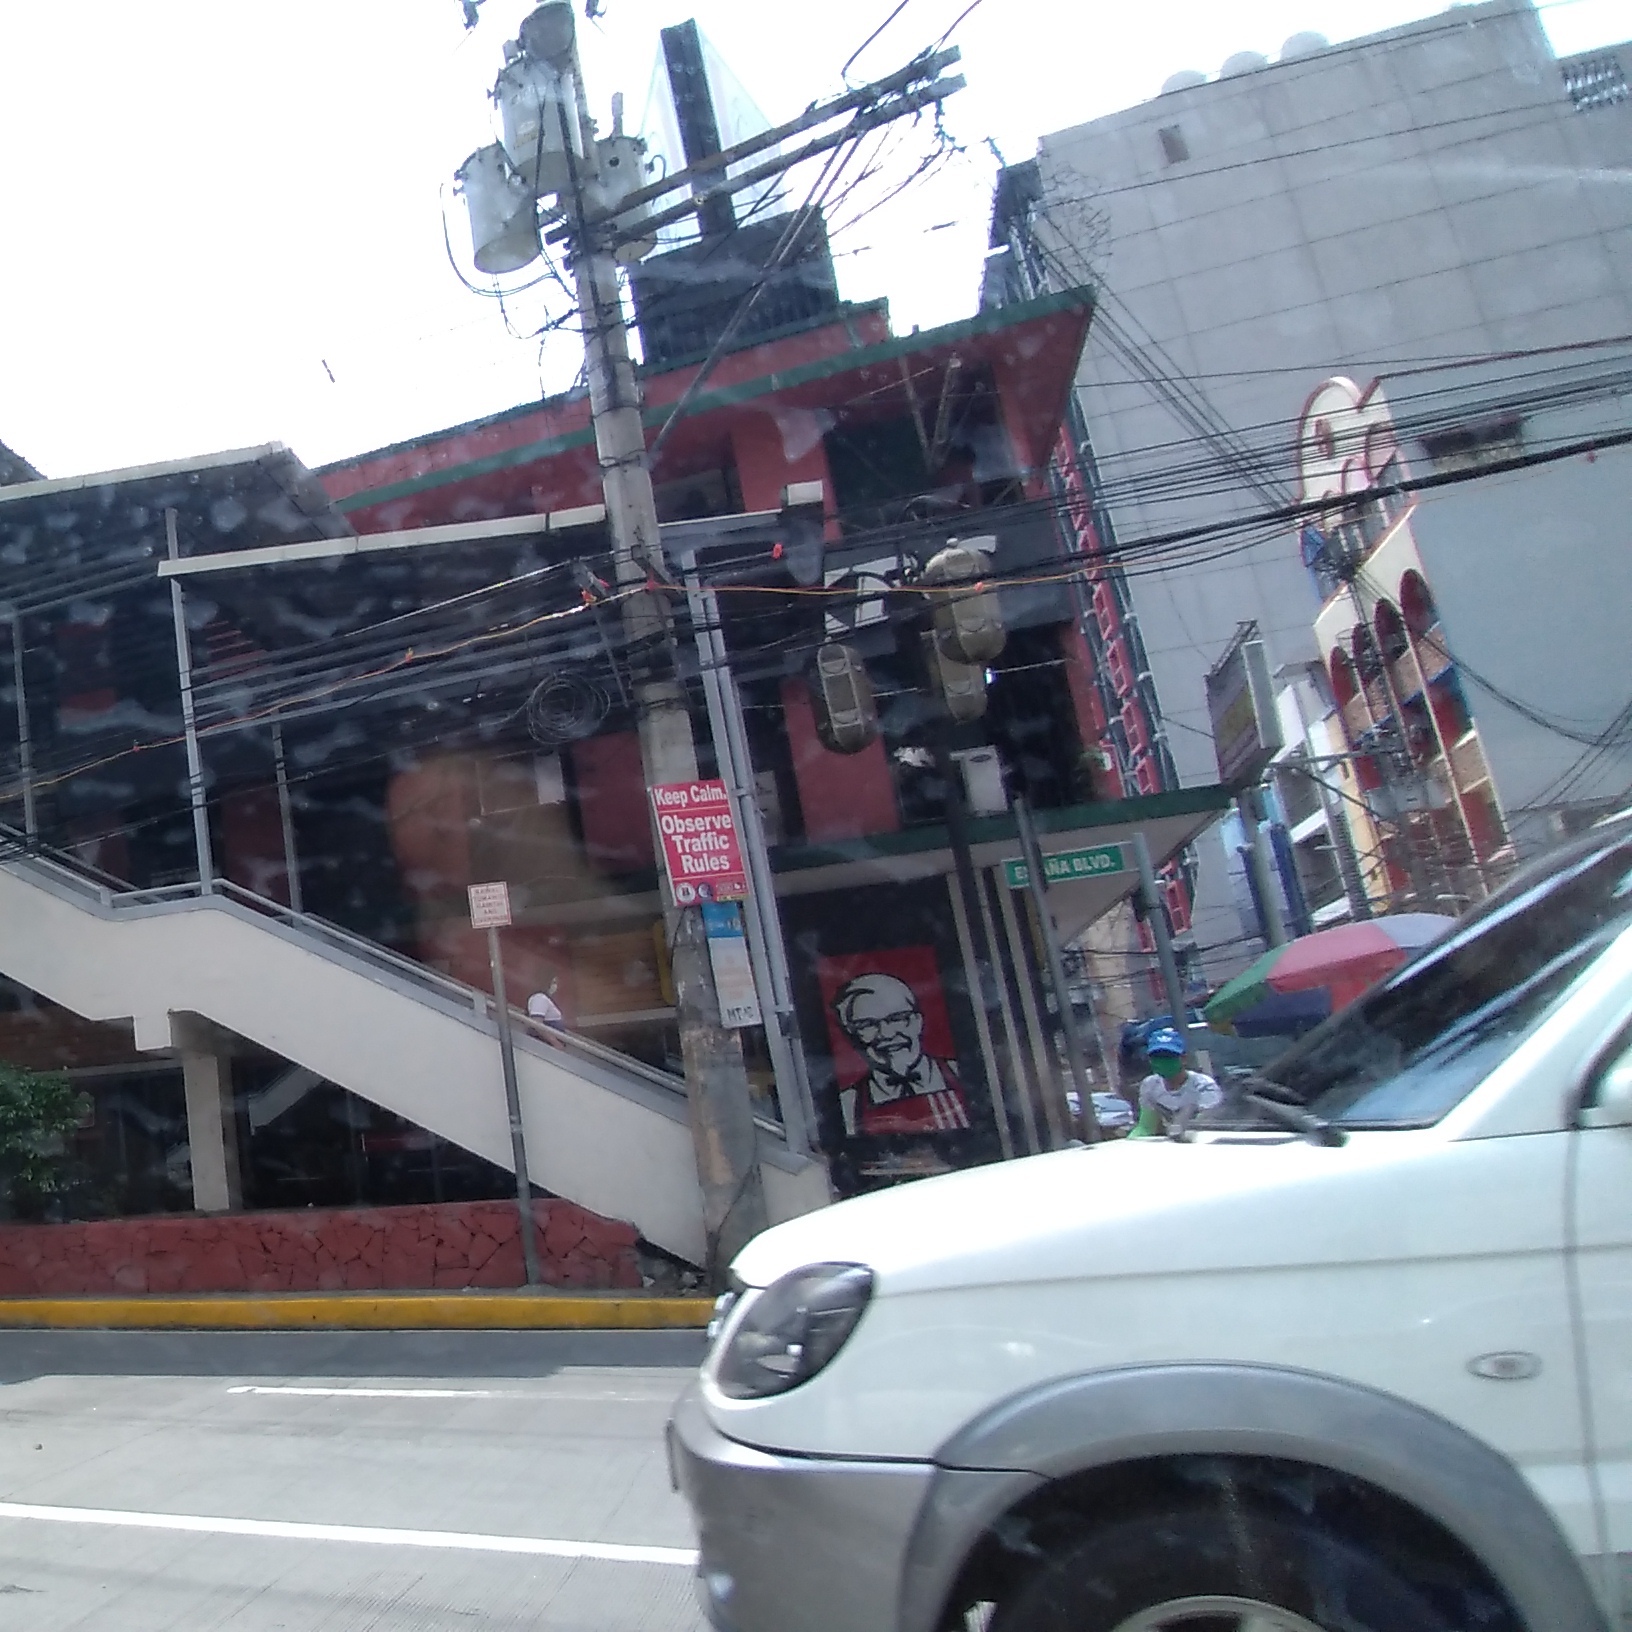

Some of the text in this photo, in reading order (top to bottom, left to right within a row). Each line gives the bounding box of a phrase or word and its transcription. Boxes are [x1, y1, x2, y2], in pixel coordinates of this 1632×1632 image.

[654, 784, 727, 808] Keep Calm.
[661, 814, 732, 834] Observe
[671, 831, 729, 853] Traffic
[681, 853, 729, 874] Rules
[1073, 853, 1115, 872] BLVD.
